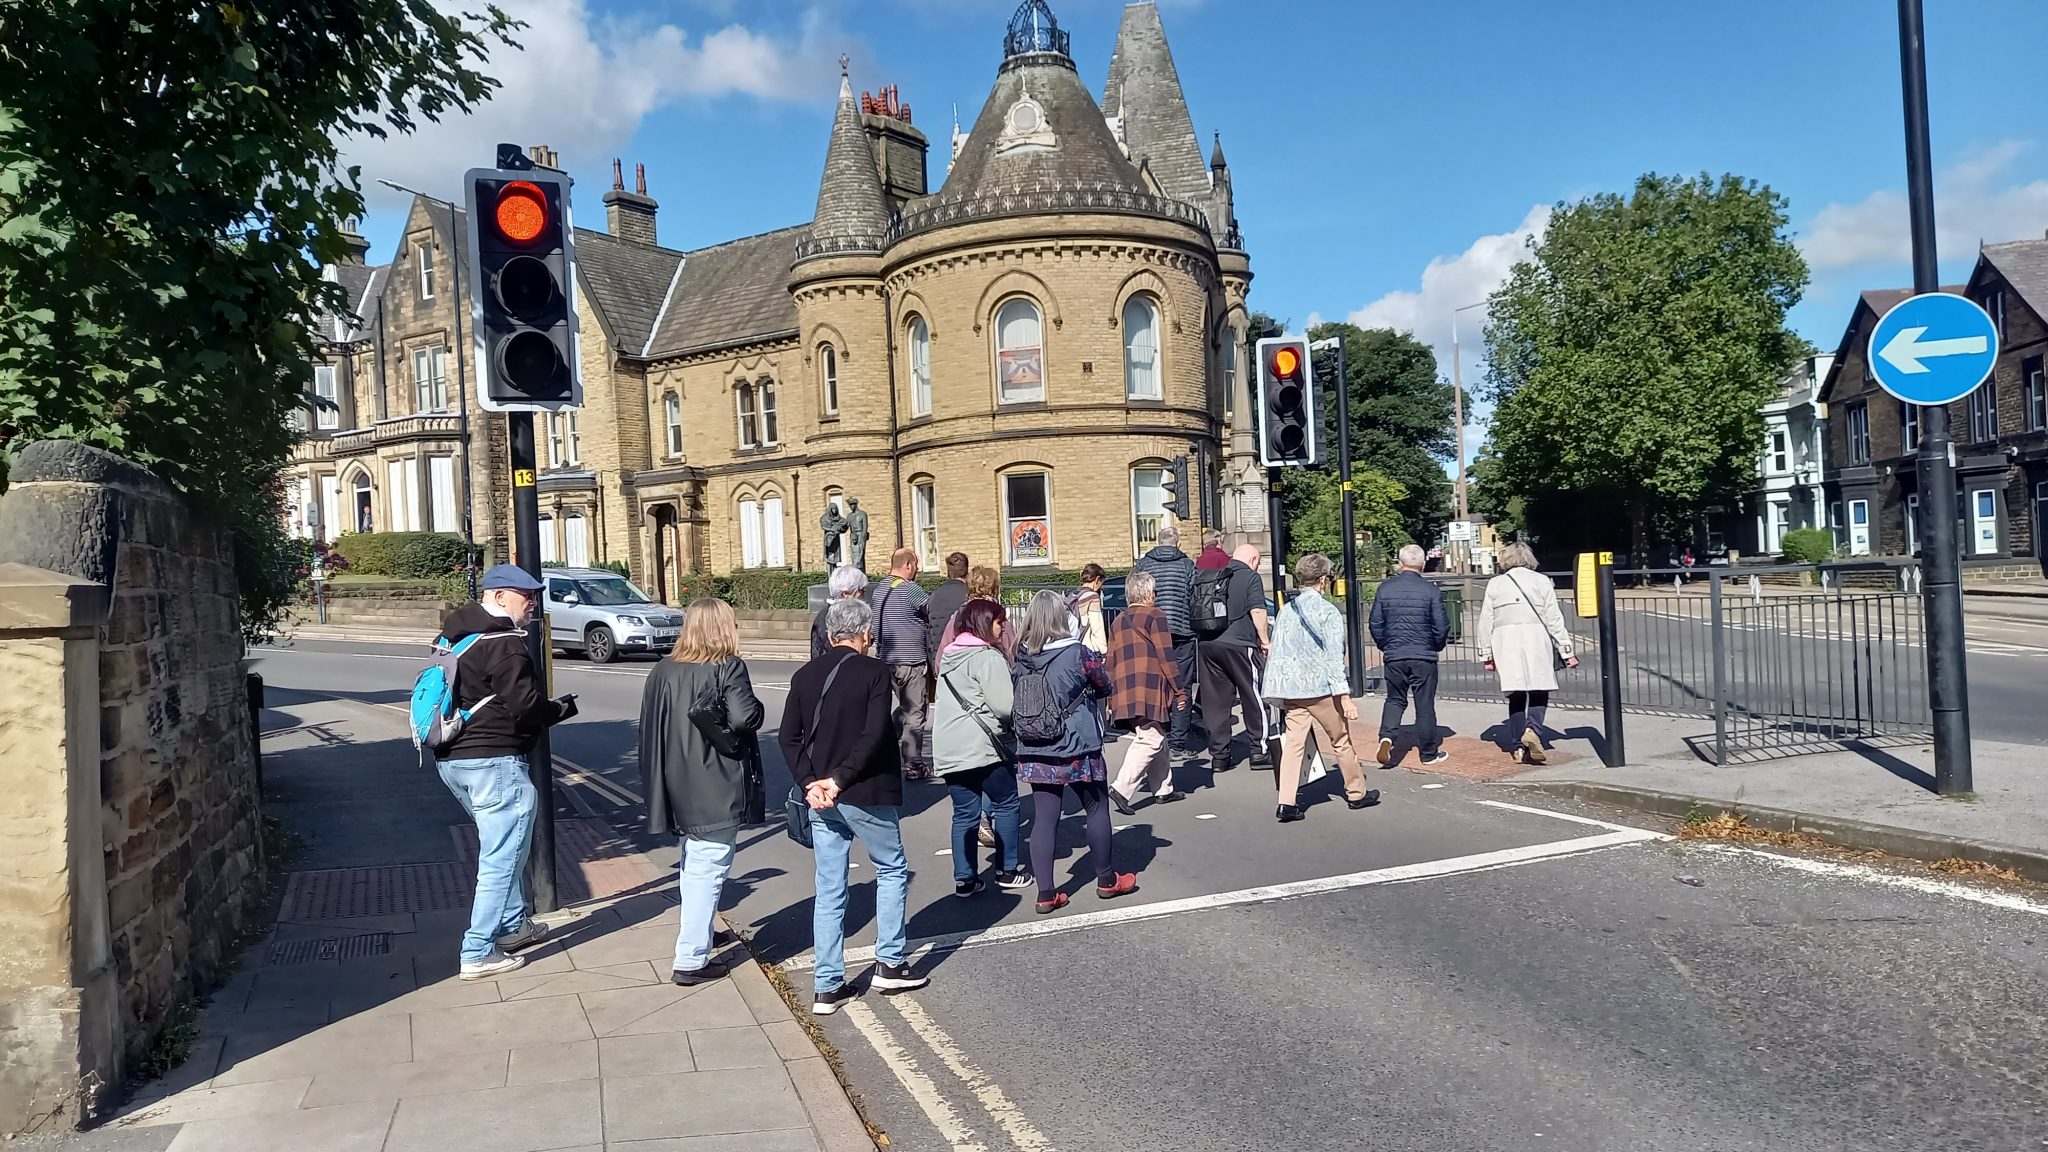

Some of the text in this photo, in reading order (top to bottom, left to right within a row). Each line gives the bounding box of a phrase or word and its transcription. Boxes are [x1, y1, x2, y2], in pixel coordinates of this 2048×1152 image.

[517, 471, 534, 484] 13
[1137, 518, 1157, 542] NO
[1601, 553, 1613, 563] 14
